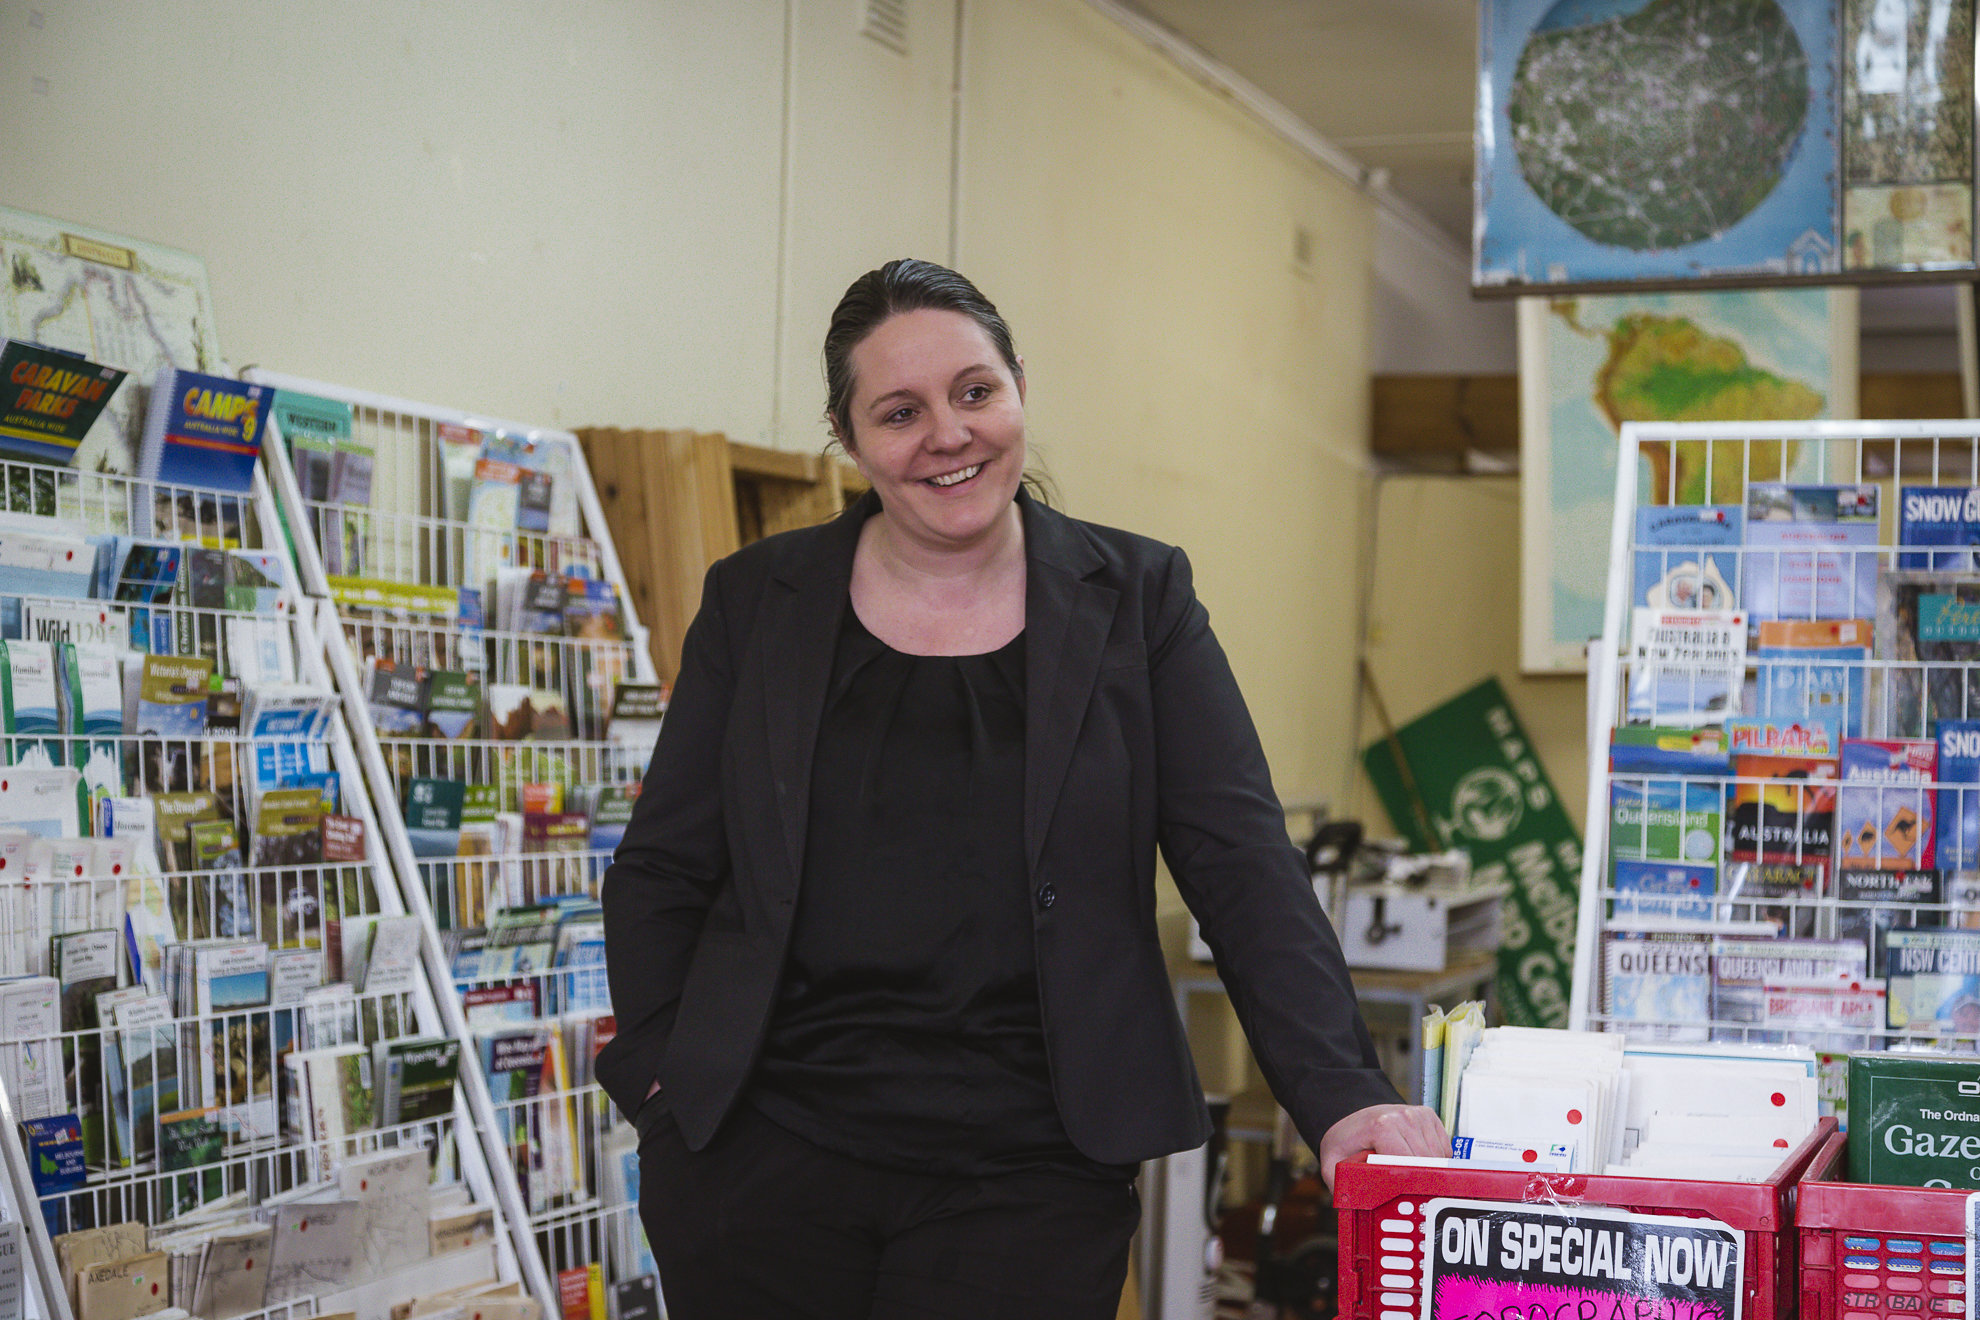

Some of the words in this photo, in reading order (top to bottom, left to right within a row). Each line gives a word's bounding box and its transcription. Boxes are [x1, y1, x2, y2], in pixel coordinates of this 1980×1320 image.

[10, 361, 107, 402] CARAVAN
[15, 388, 78, 419] PARKS
[183, 387, 259, 422] CAMPS
[4, 414, 45, 429] AUSTRALIA
[242, 415, 257, 442] 9
[1905, 494, 1962, 523] SNOW
[1778, 669, 1845, 689] DIARY
[1732, 724, 1832, 748] PILBARA
[1849, 765, 1933, 784] Australia
[1615, 807, 1708, 828] Queensland
[1738, 825, 1830, 845] AUSTRALIA
[1902, 949, 1934, 972] NSW
[1920, 1108, 1942, 1120] The
[1944, 1110, 1980, 1122] Ordna
[1884, 1124, 1980, 1160] Gaze
[1441, 1216, 1490, 1266] ON
[1500, 1220, 1632, 1280] SPECIAL
[1644, 1234, 1731, 1289] NOW
[1843, 1293, 1945, 1312] STRBAE
